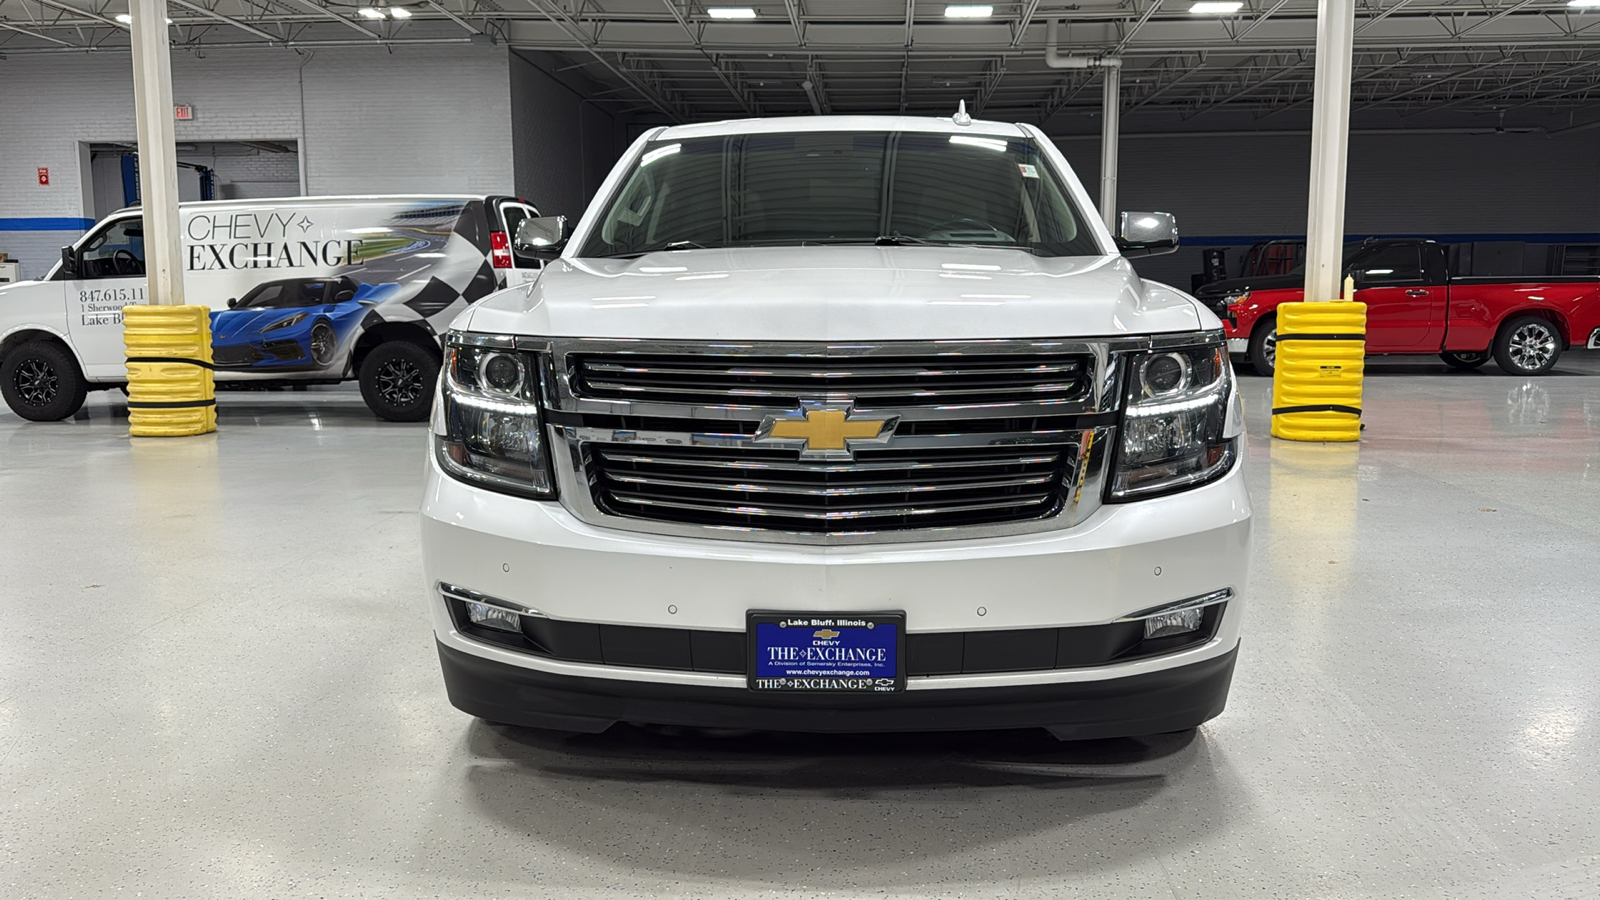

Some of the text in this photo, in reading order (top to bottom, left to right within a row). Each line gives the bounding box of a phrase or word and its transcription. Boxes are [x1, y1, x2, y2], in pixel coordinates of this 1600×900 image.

[176, 107, 189, 118] EXIT
[188, 213, 296, 241] CHEVY
[187, 239, 365, 272] EXCHANGE
[80, 288, 144, 303] 847.615.11
[81, 313, 109, 326] Lake
[837, 619, 866, 627] Illinois
[767, 646, 887, 662] THE EXCHANGE
[786, 669, 870, 677] www.chevyexchange.com
[756, 679, 867, 689] THE EXCHANGE
